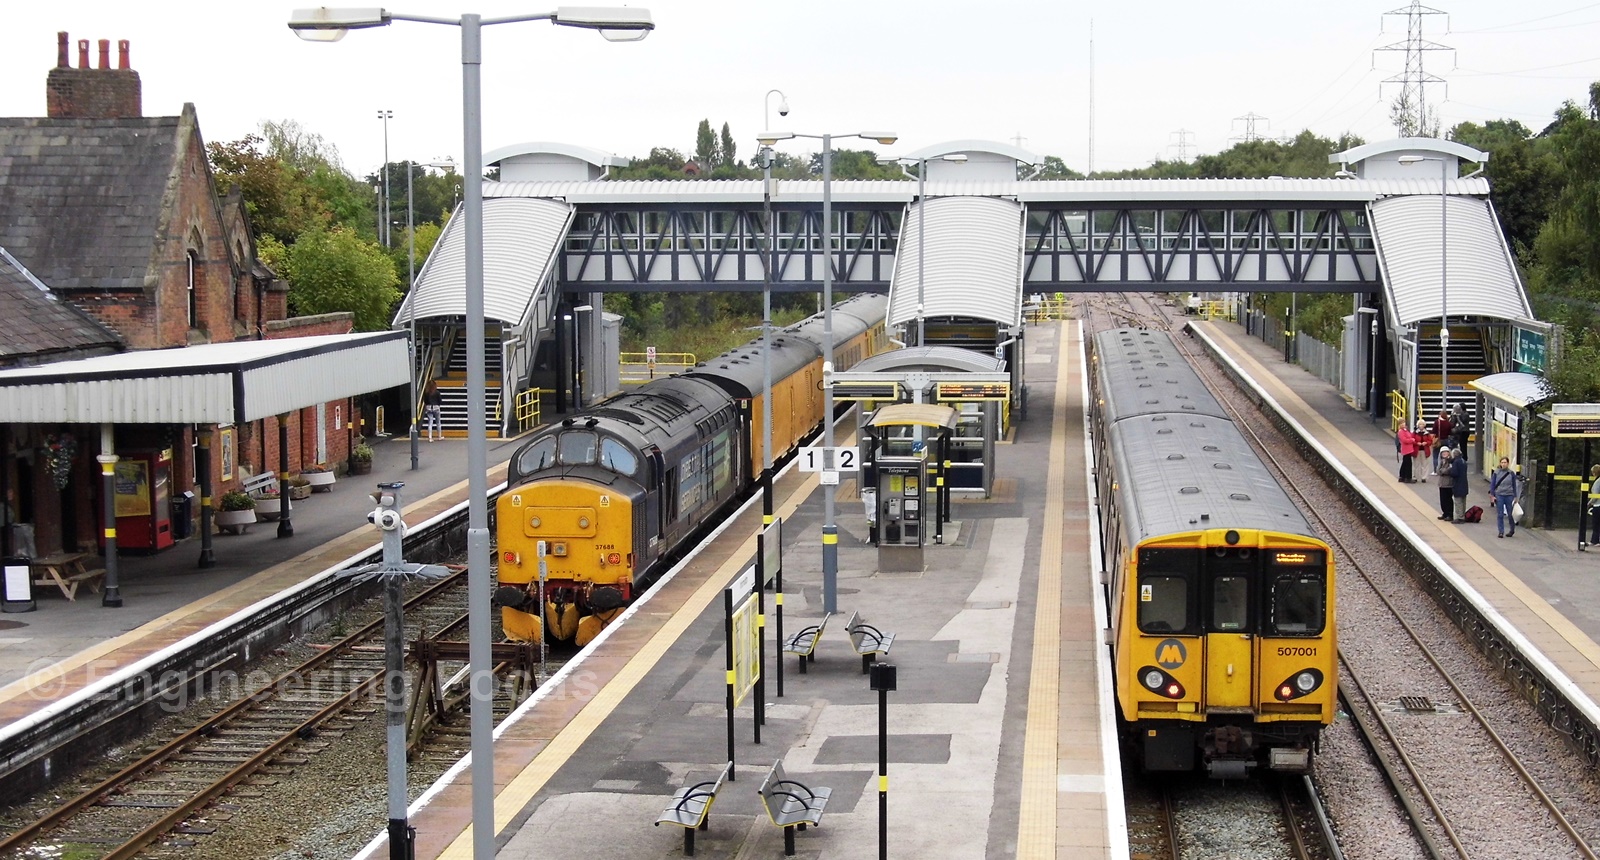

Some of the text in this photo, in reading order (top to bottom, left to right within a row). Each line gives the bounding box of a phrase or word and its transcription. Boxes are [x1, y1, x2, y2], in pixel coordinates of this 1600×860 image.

[807, 451, 813, 468] 1
[840, 450, 854, 468] 2
[1277, 647, 1317, 657] 507001
